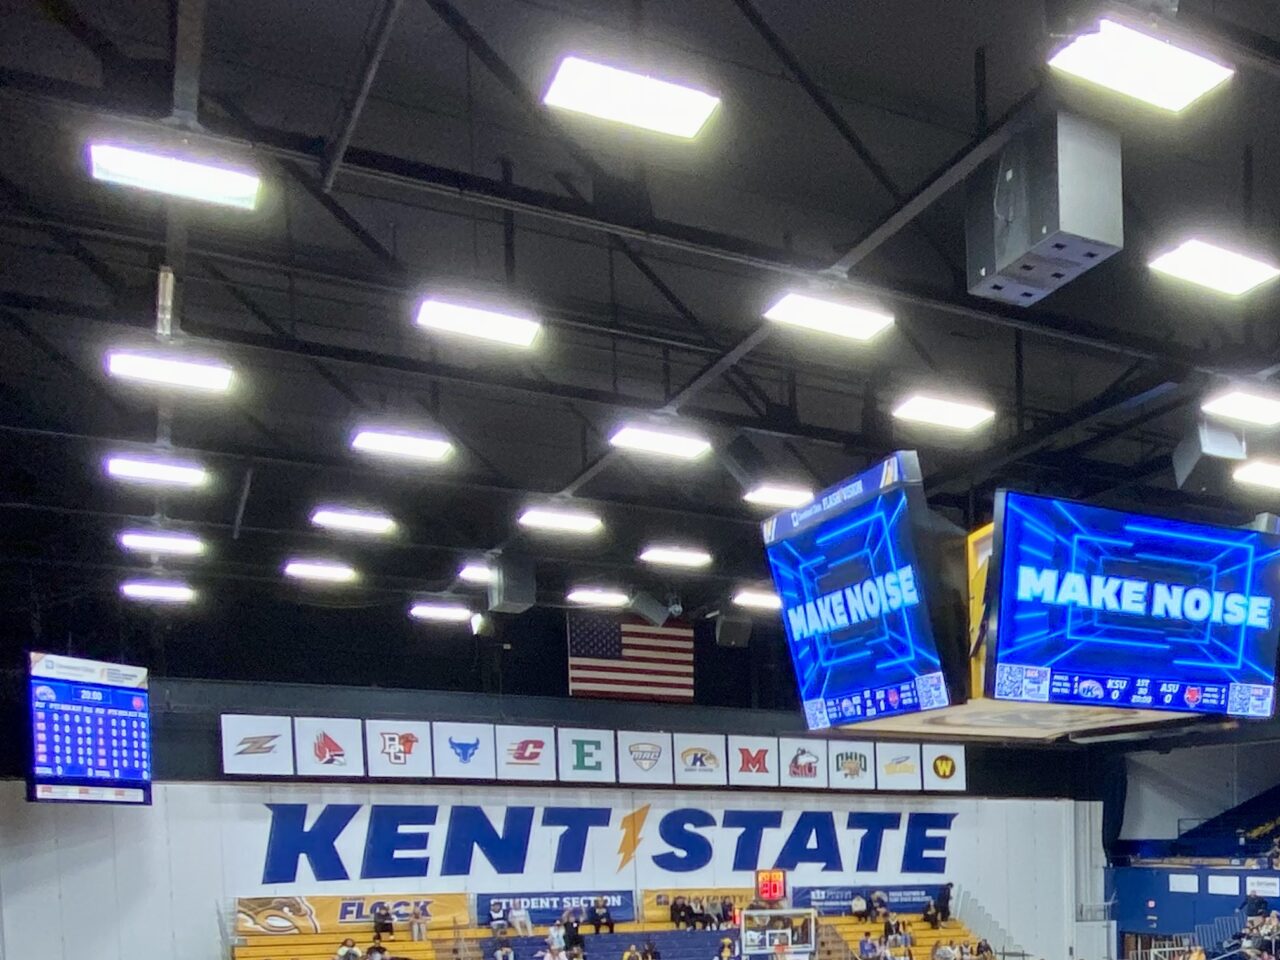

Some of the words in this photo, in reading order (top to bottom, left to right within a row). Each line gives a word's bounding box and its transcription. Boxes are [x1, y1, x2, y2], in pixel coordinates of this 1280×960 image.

[787, 591, 850, 642] MAKE
[845, 564, 919, 622] NOISE
[1017, 565, 1147, 610] MAKE
[1151, 580, 1272, 630] NOISE
[1107, 678, 1127, 689] KSU
[1160, 683, 1180, 693] ASU
[1111, 690, 1119, 699] 0
[571, 739, 602, 771] E
[738, 748, 769, 773] M
[835, 752, 868, 772] OHIO
[937, 758, 953, 776] W
[261, 802, 612, 885] KENT
[651, 807, 960, 875] STATE
[563, 895, 622, 908] SECTON
